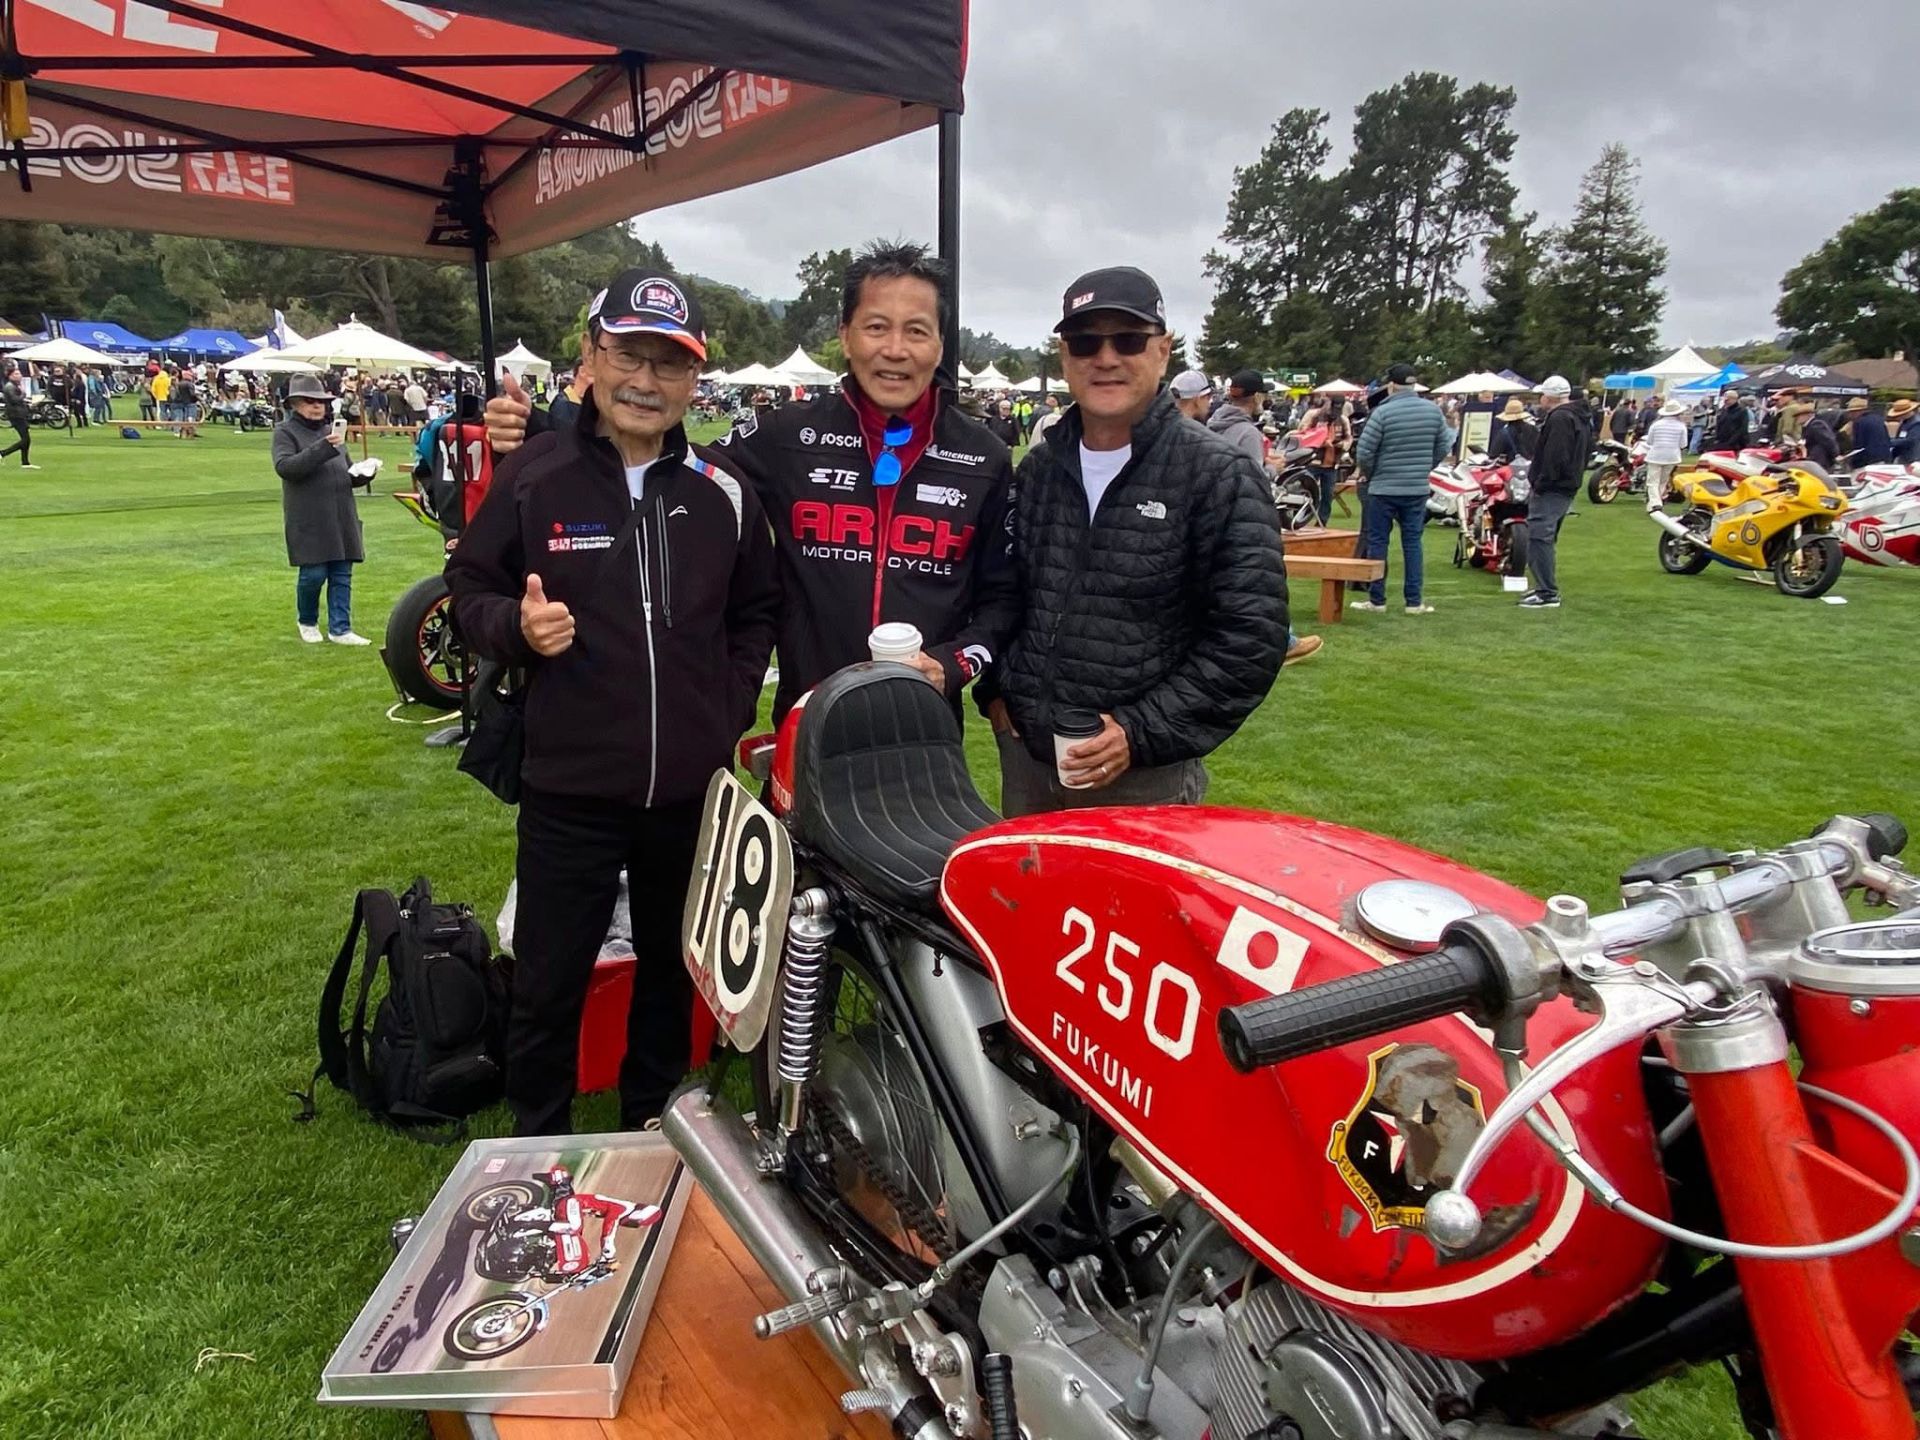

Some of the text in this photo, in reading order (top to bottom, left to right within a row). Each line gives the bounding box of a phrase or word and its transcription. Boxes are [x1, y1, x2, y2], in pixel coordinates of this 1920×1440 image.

[939, 449, 986, 463] MICHELIN
[565, 523, 607, 532] SUZUKI
[792, 501, 975, 561] ARCH
[1741, 519, 1761, 545] 6
[802, 544, 952, 576] MOTOR CYCLE
[690, 776, 777, 1013] 18
[1055, 906, 1201, 1061] 250
[1052, 1011, 1154, 1118] FUKUMI
[1363, 1140, 1379, 1159] F
